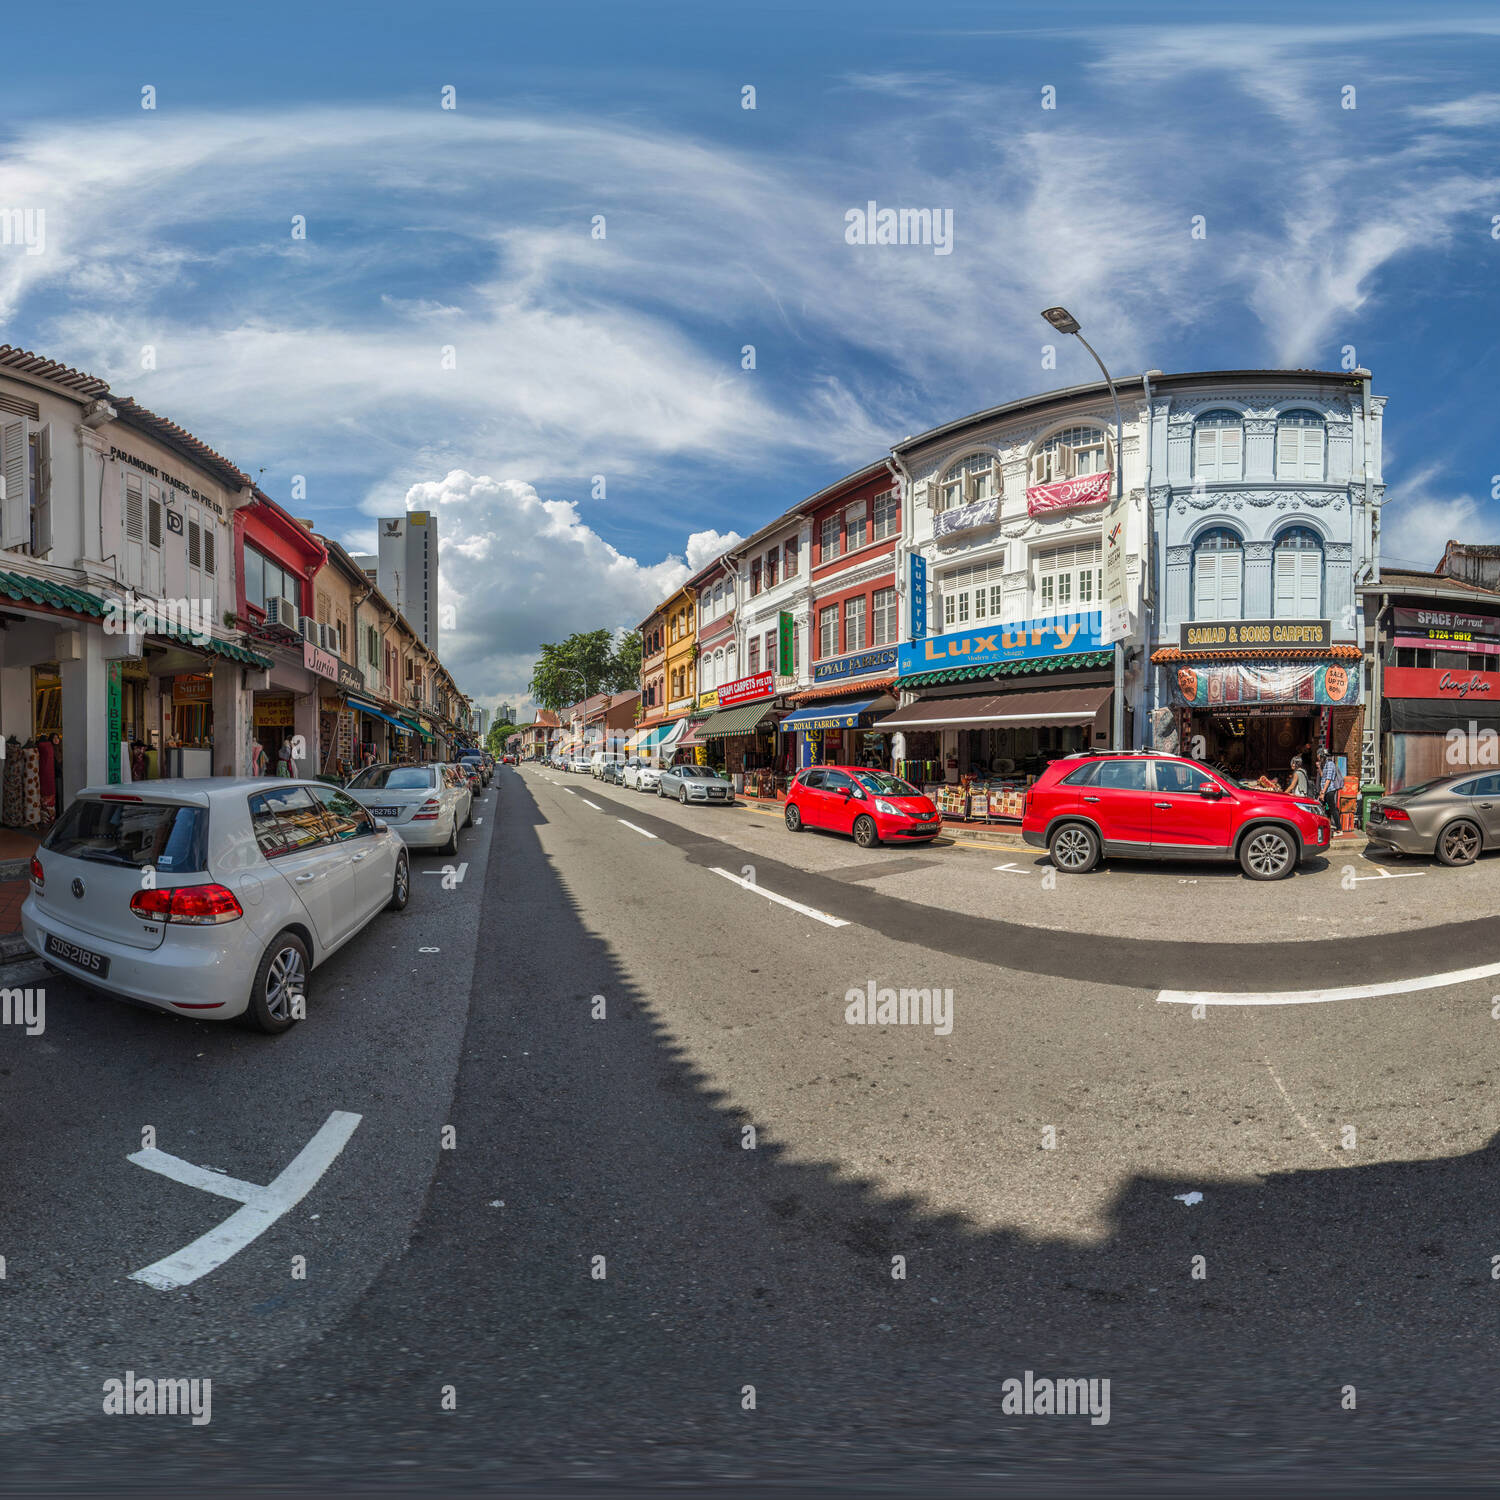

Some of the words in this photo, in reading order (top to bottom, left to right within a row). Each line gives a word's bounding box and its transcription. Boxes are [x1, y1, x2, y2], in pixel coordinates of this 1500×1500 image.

[110, 446, 159, 477] PARAMOUNT
[161, 472, 190, 495] TRADERS
[201, 495, 212, 508] PTE
[213, 502, 223, 515] LTD
[1417, 611, 1451, 626] SPACE
[1453, 615, 1464, 630] for
[1467, 617, 1483, 627] rent
[925, 623, 1081, 660] Luxury
[1188, 627, 1226, 644] SAMAD
[1229, 627, 1238, 643] &
[1240, 626, 1270, 642] SONS
[1273, 625, 1323, 642] CARPETS
[308, 648, 335, 678] Suria
[849, 650, 896, 669] FABRICS
[1329, 670, 1343, 679] SALE
[734, 677, 756, 694] CARPETS
[1439, 672, 1491, 697] Anglia
[110, 685, 120, 763] LIBERTY
[793, 720, 813, 730] ROYAL
[814, 718, 840, 729] FABRICS
[143, 925, 159, 934] TSI
